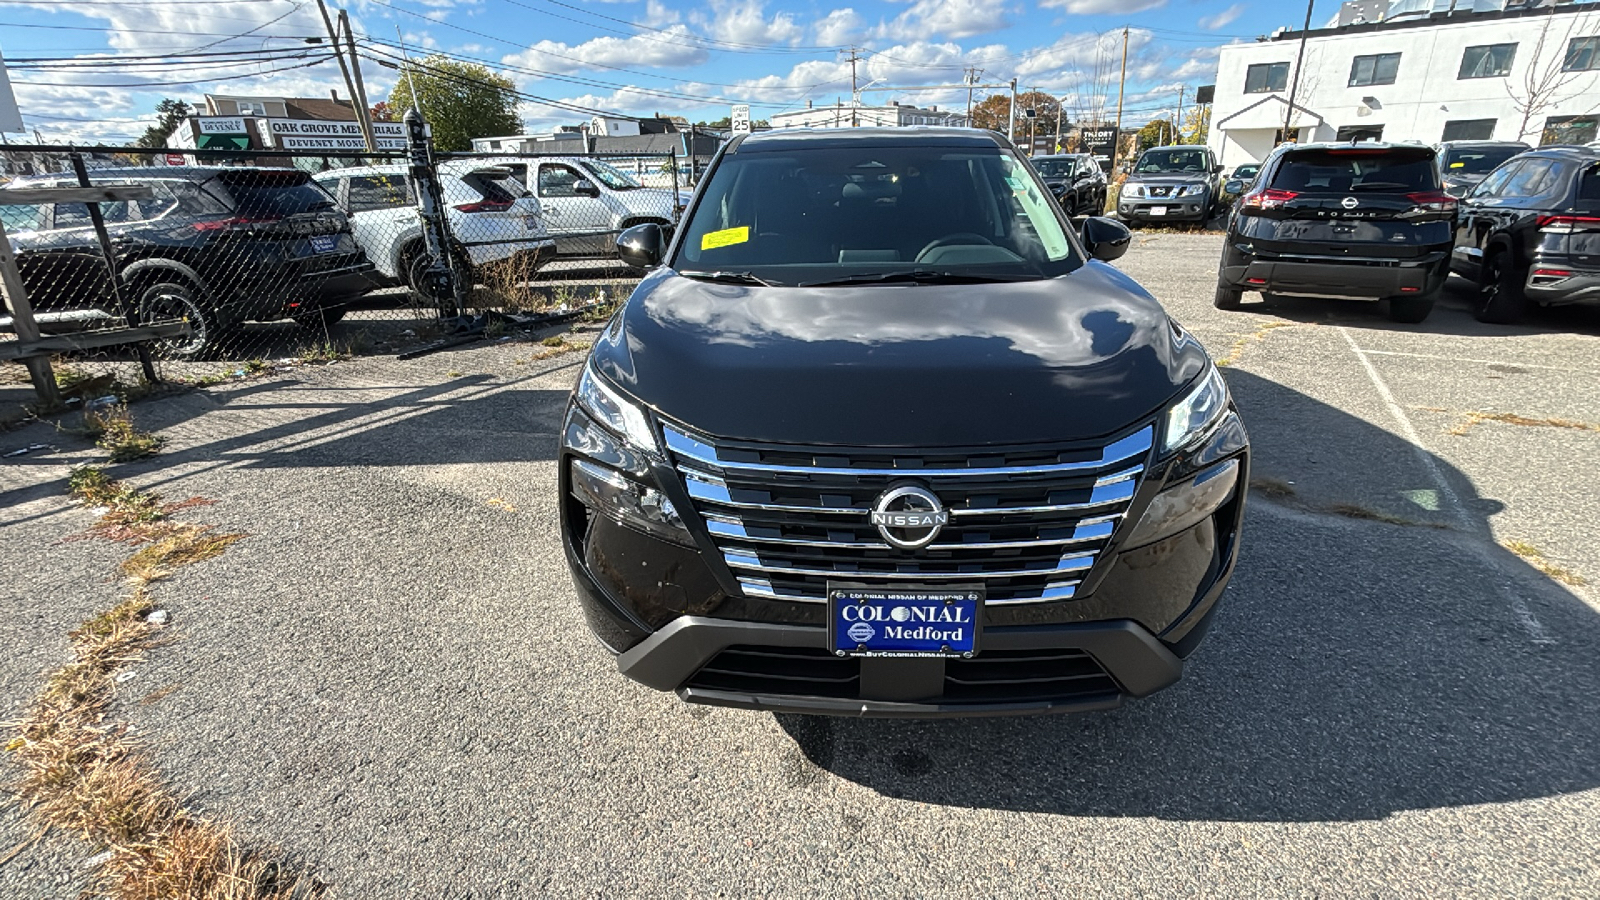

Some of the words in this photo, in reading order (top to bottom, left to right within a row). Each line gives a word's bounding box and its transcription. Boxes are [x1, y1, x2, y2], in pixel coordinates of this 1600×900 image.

[273, 123, 299, 133] OAK
[300, 123, 339, 134] GROVE
[734, 120, 748, 130] 25
[289, 139, 334, 147] DEVENEY
[337, 140, 393, 148] MONUNTS
[873, 513, 946, 526] NISSAN
[842, 605, 970, 623] COLONIAL
[883, 626, 963, 641] Medford
